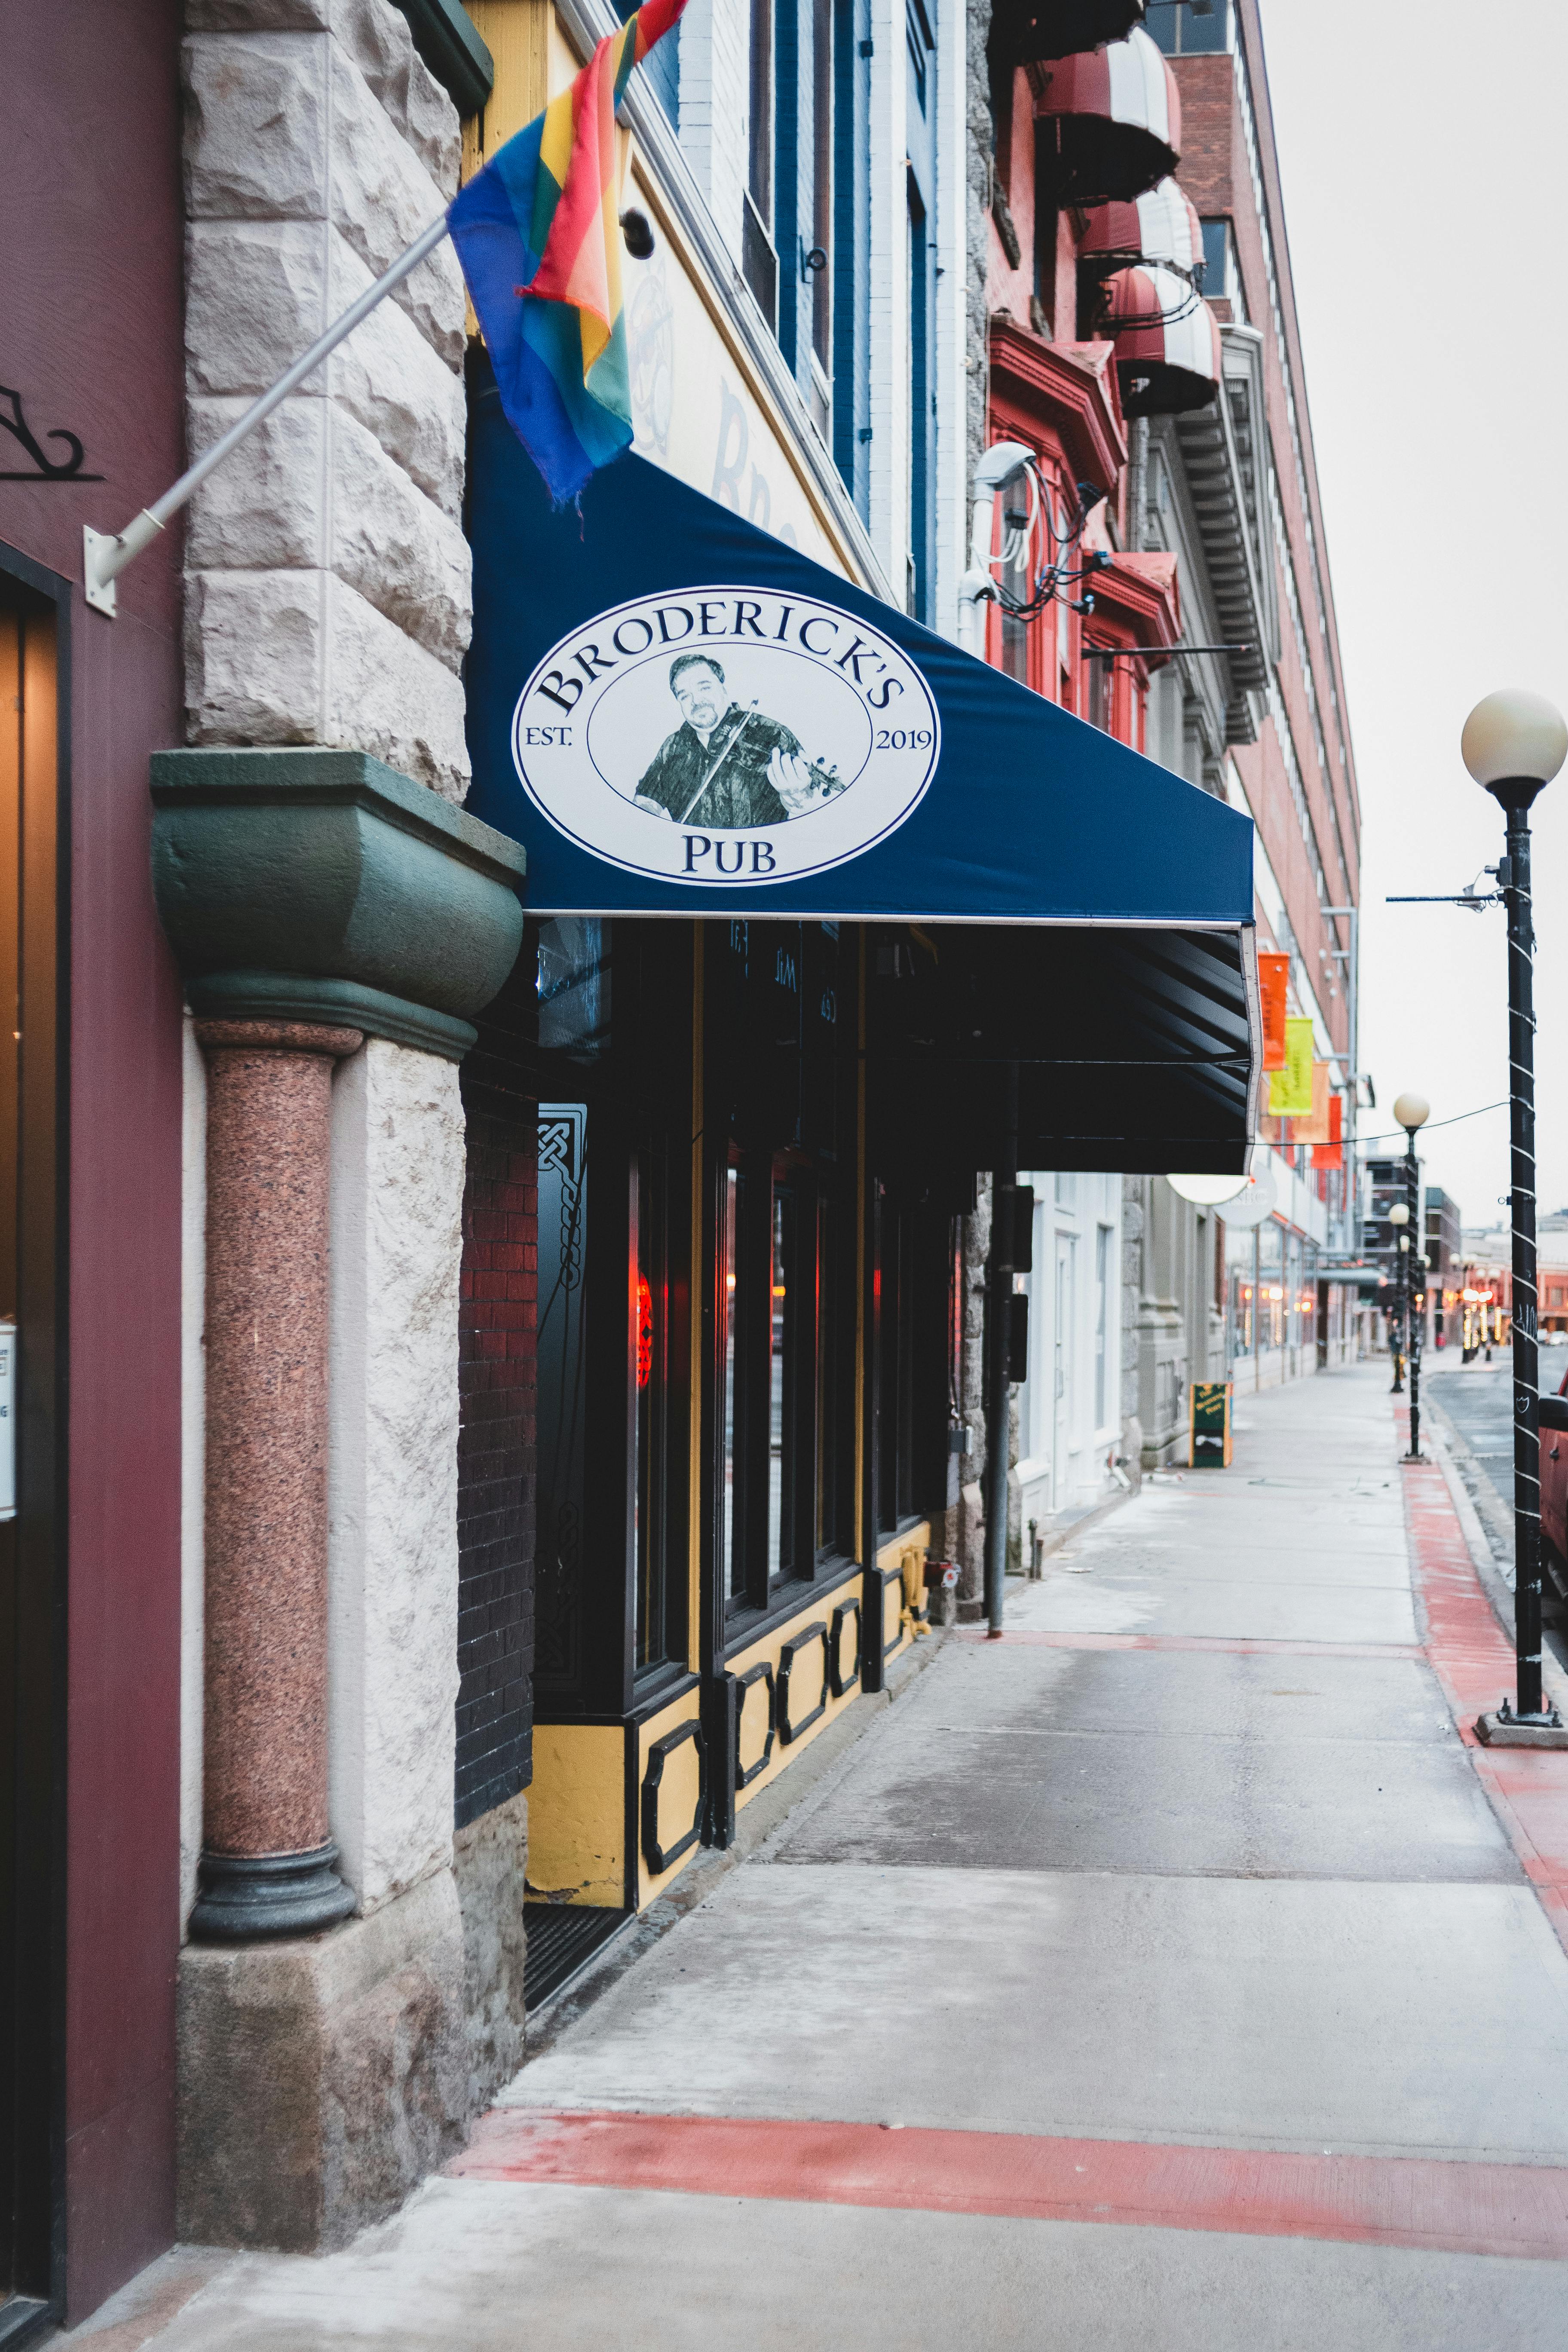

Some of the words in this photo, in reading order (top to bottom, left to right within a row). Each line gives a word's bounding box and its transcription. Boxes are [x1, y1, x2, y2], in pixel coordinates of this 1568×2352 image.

[534, 601, 904, 717] BRODERICK'S
[525, 727, 573, 746] EST.
[876, 730, 932, 750] 2019
[680, 835, 776, 873] PUB
